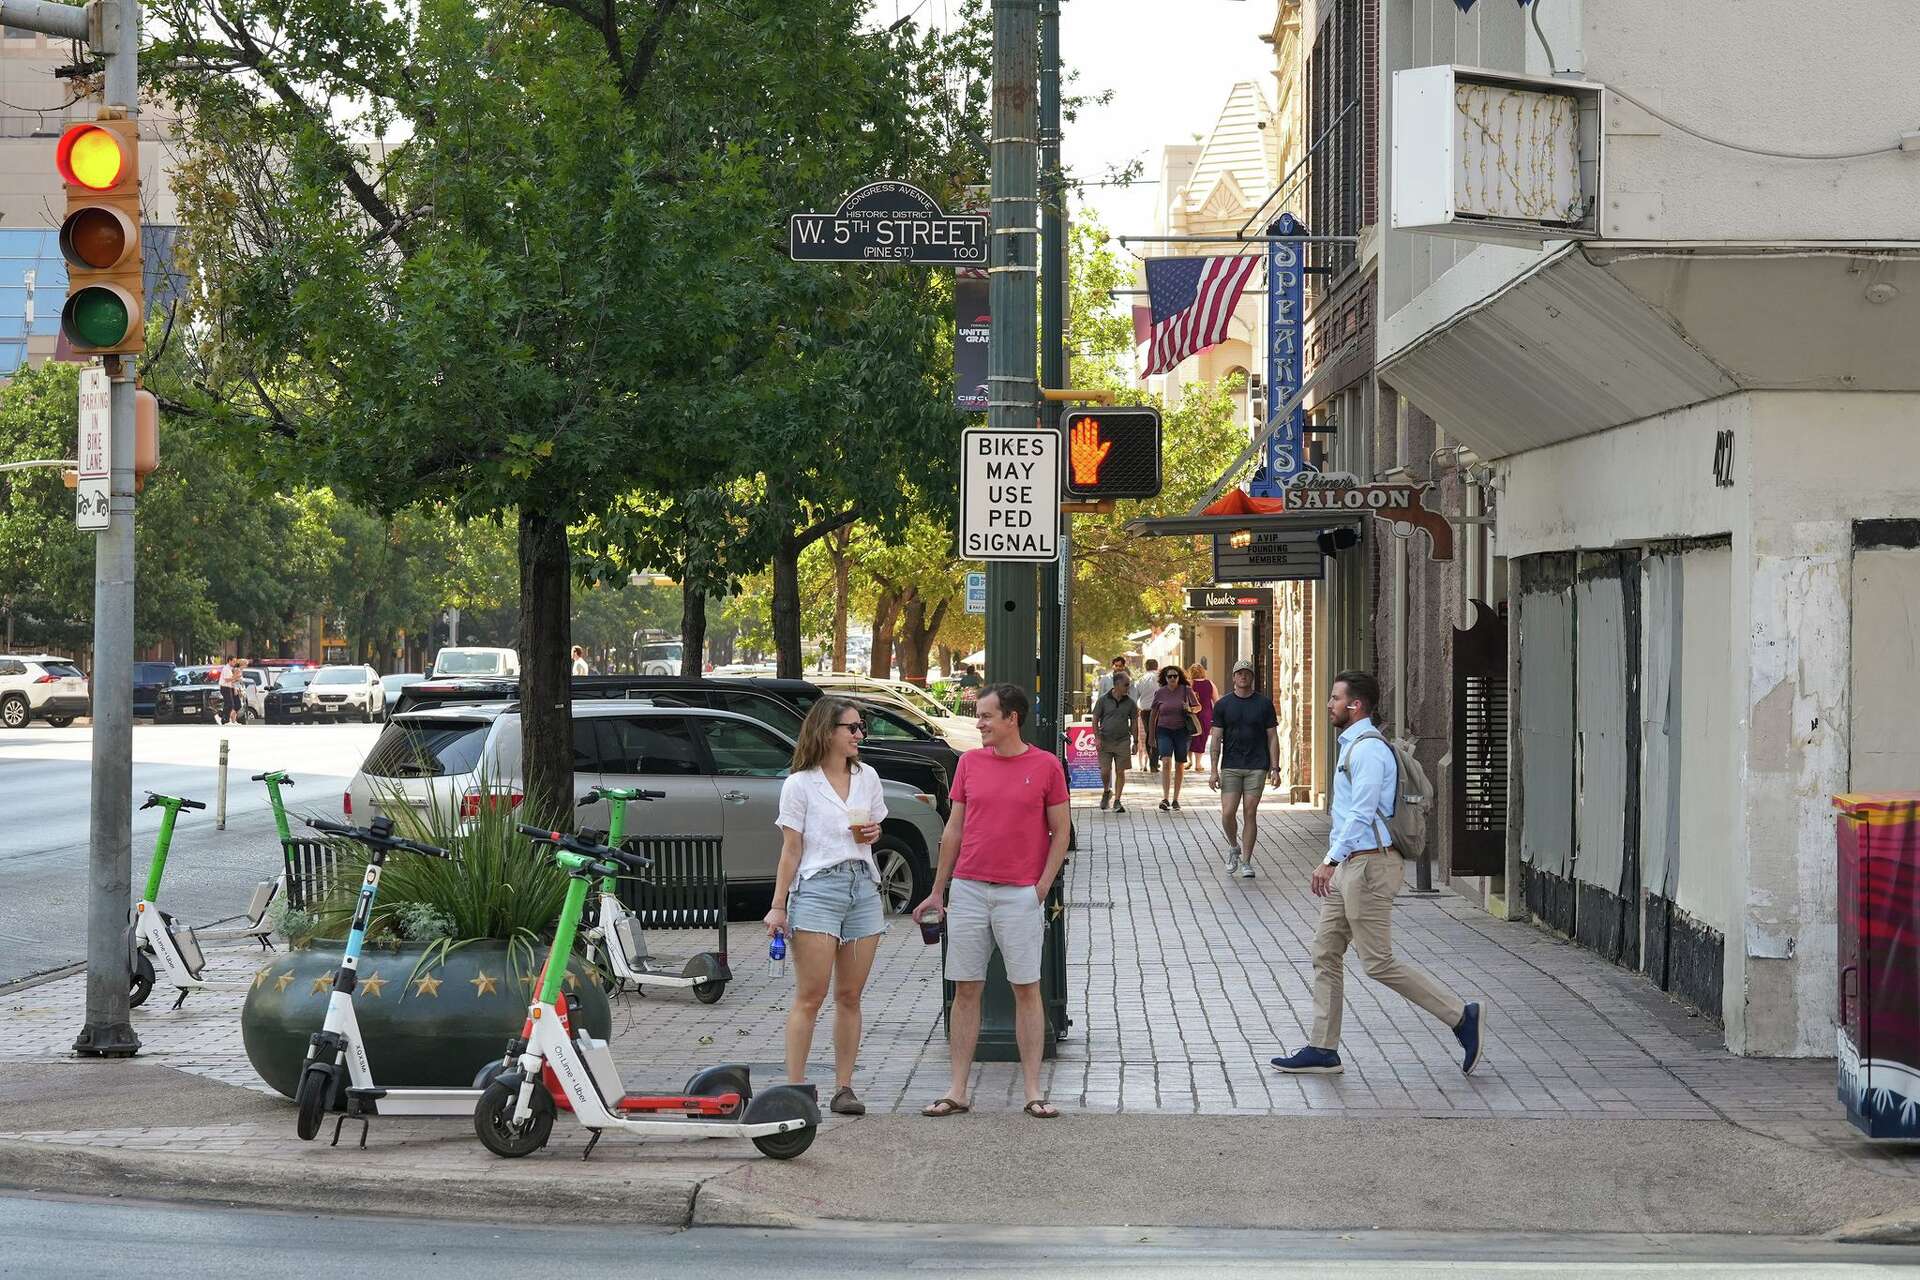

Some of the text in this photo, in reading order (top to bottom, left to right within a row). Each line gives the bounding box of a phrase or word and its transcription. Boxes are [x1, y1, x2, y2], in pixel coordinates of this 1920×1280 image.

[846, 184, 933, 210] CONGRESS AVENUE
[846, 210, 933, 219] HISTORIC DISTRICT
[797, 219, 983, 246] W. 5TH STREET
[863, 246, 891, 258] (PINE
[952, 247, 979, 258] 100
[958, 328, 990, 336] UNITE
[90, 373, 100, 390] NO
[81, 391, 109, 411] PARKING
[91, 413, 99, 430] IN
[87, 433, 102, 451] BIKE
[979, 437, 1044, 456] BIKES
[85, 453, 103, 471] LANE
[986, 461, 1036, 480] MAY
[988, 485, 1033, 504] USE
[1288, 489, 1411, 508] SALOON
[988, 509, 1032, 528] PED
[968, 532, 1052, 552] SIGNAL
[1248, 544, 1289, 554] FOUNDING
[1249, 555, 1288, 565] MEMBERS
[1205, 592, 1236, 607] Newk's
[554, 1045, 564, 1059] On
[560, 1058, 573, 1077] Lime
[574, 1083, 586, 1102] Uber
